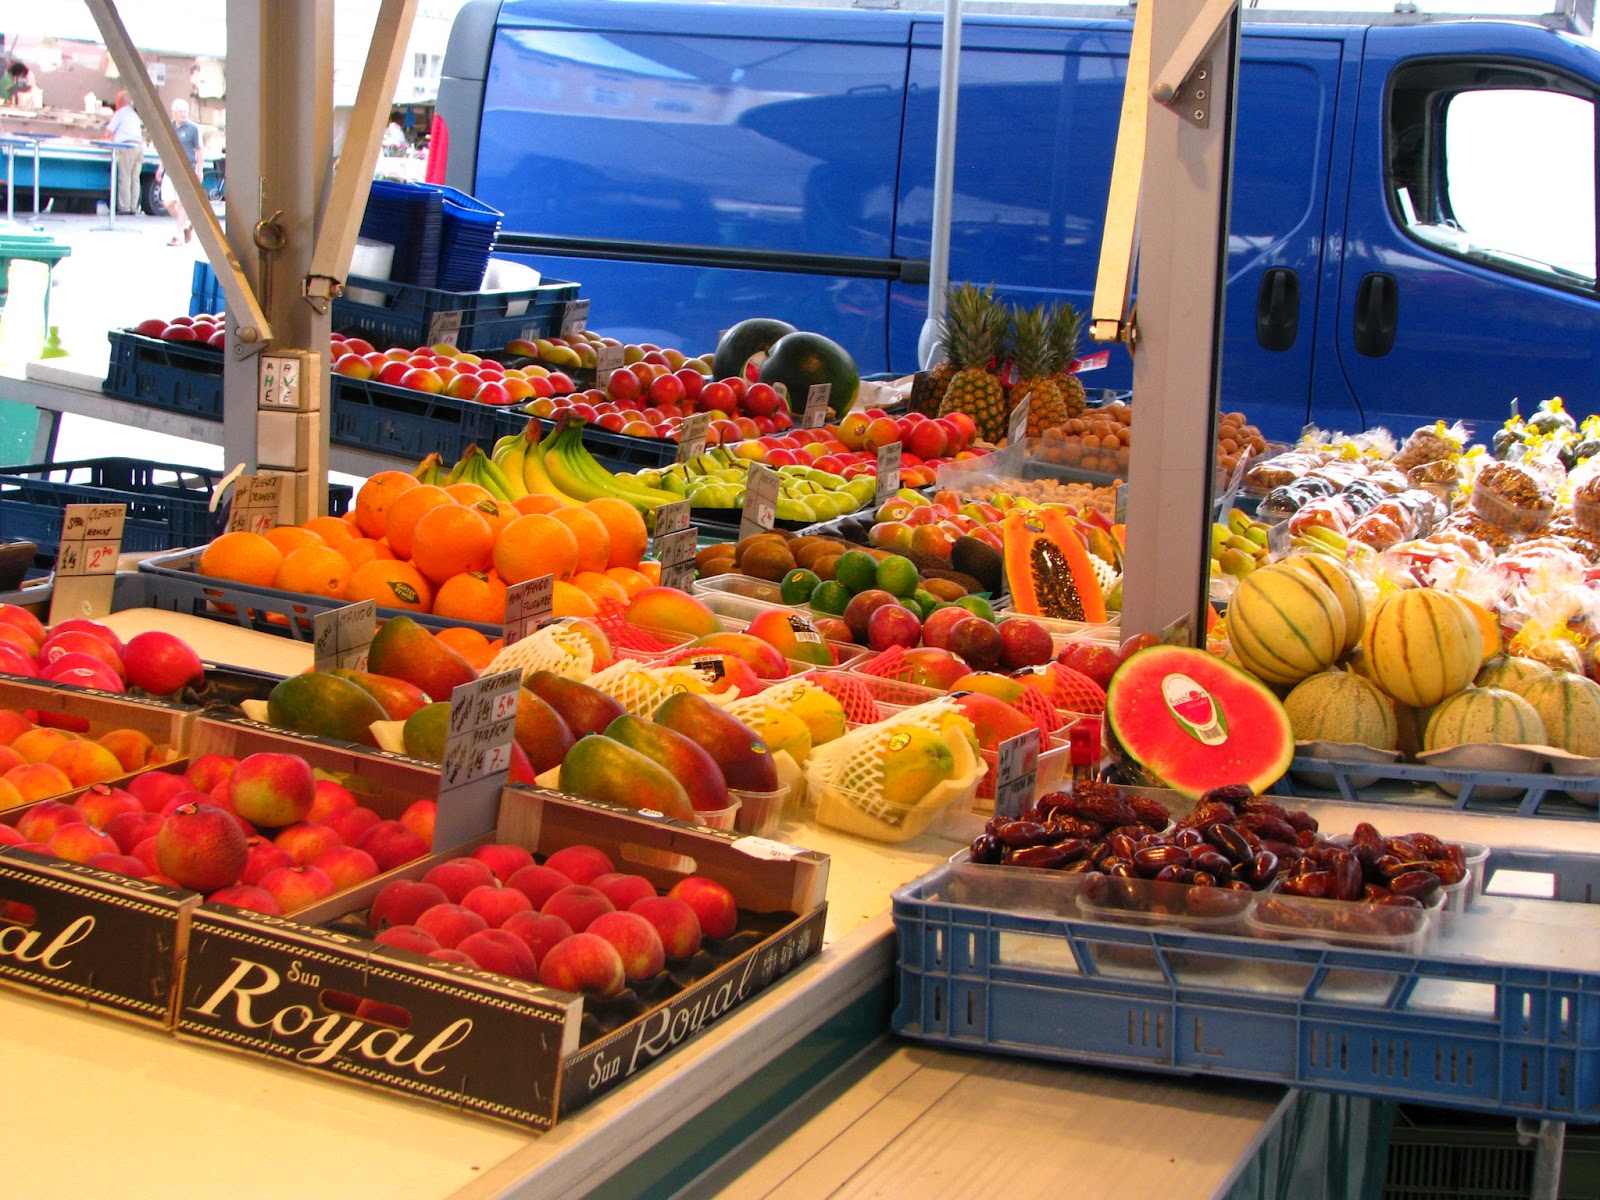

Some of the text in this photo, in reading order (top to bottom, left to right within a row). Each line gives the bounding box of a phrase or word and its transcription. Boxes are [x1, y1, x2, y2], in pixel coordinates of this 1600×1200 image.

[339, 606, 373, 626] MANGO
[0, 914, 96, 971] al
[287, 960, 321, 988] Sun
[186, 956, 474, 1076] Royal
[589, 1051, 621, 1090] Sun
[625, 948, 759, 1077] Royal
